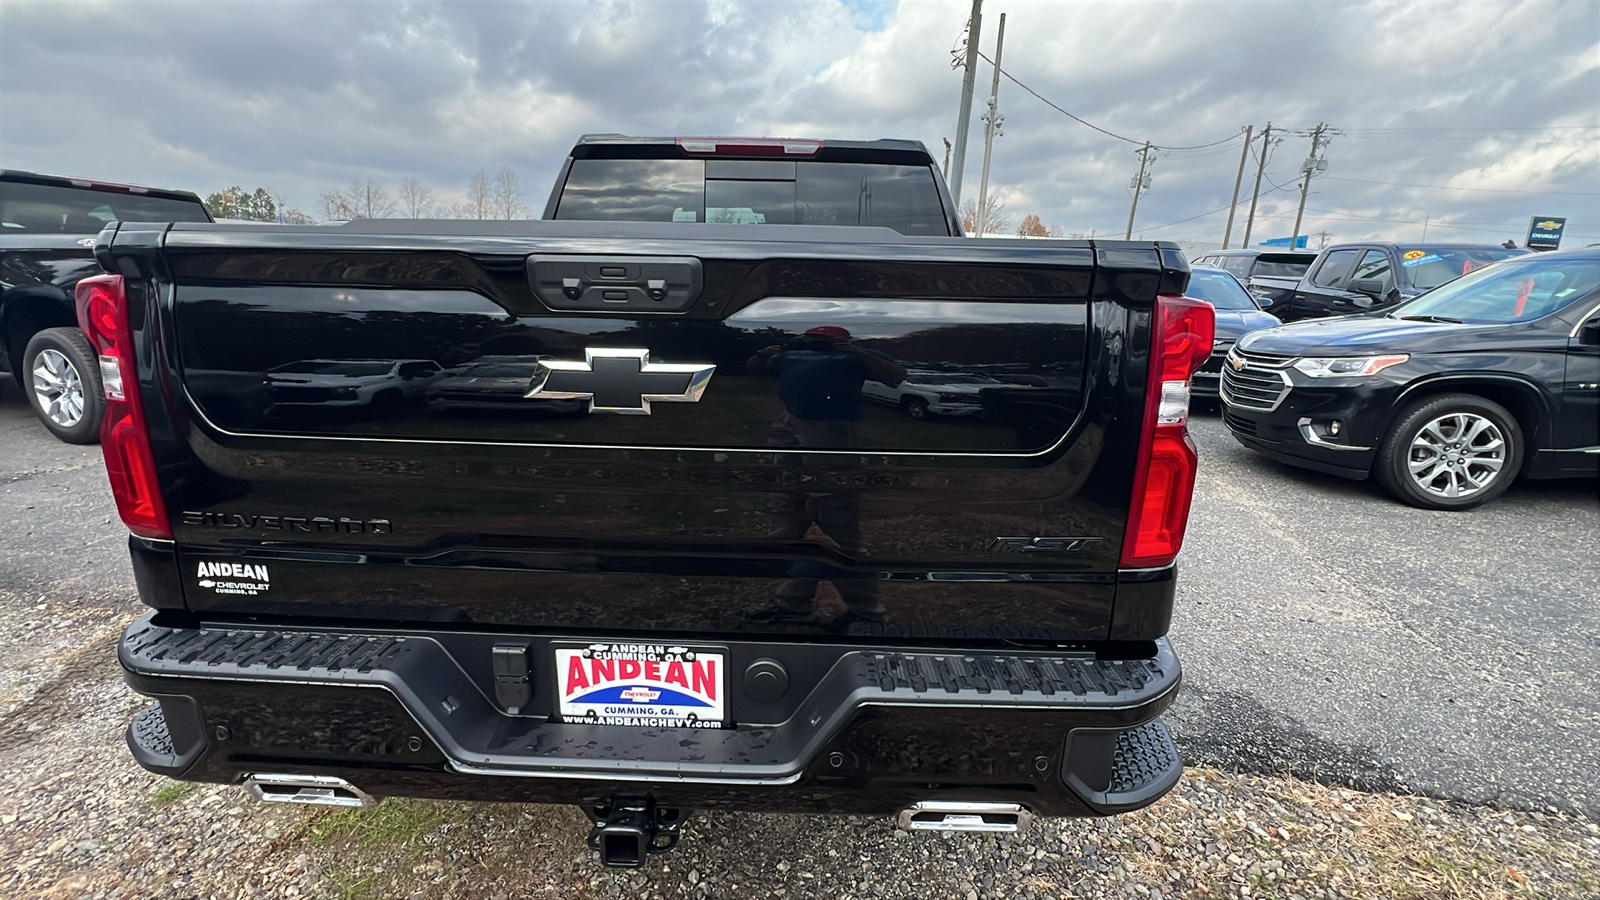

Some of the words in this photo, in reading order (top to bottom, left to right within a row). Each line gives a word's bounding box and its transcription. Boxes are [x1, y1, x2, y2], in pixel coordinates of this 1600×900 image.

[182, 510, 393, 534] SILVERADO
[197, 561, 269, 582] ANDEAN
[216, 581, 270, 591] CHEVROLET
[611, 644, 665, 654] ANDEAN
[593, 652, 661, 662] CUMMING,
[664, 654, 684, 663] GA
[566, 655, 716, 702] ANDEAN
[624, 690, 658, 699] CHEVROLET
[604, 706, 659, 716] CUMMING,
[660, 708, 679, 716] GA.
[563, 715, 722, 729] www.ANDEANCHEVY.com
